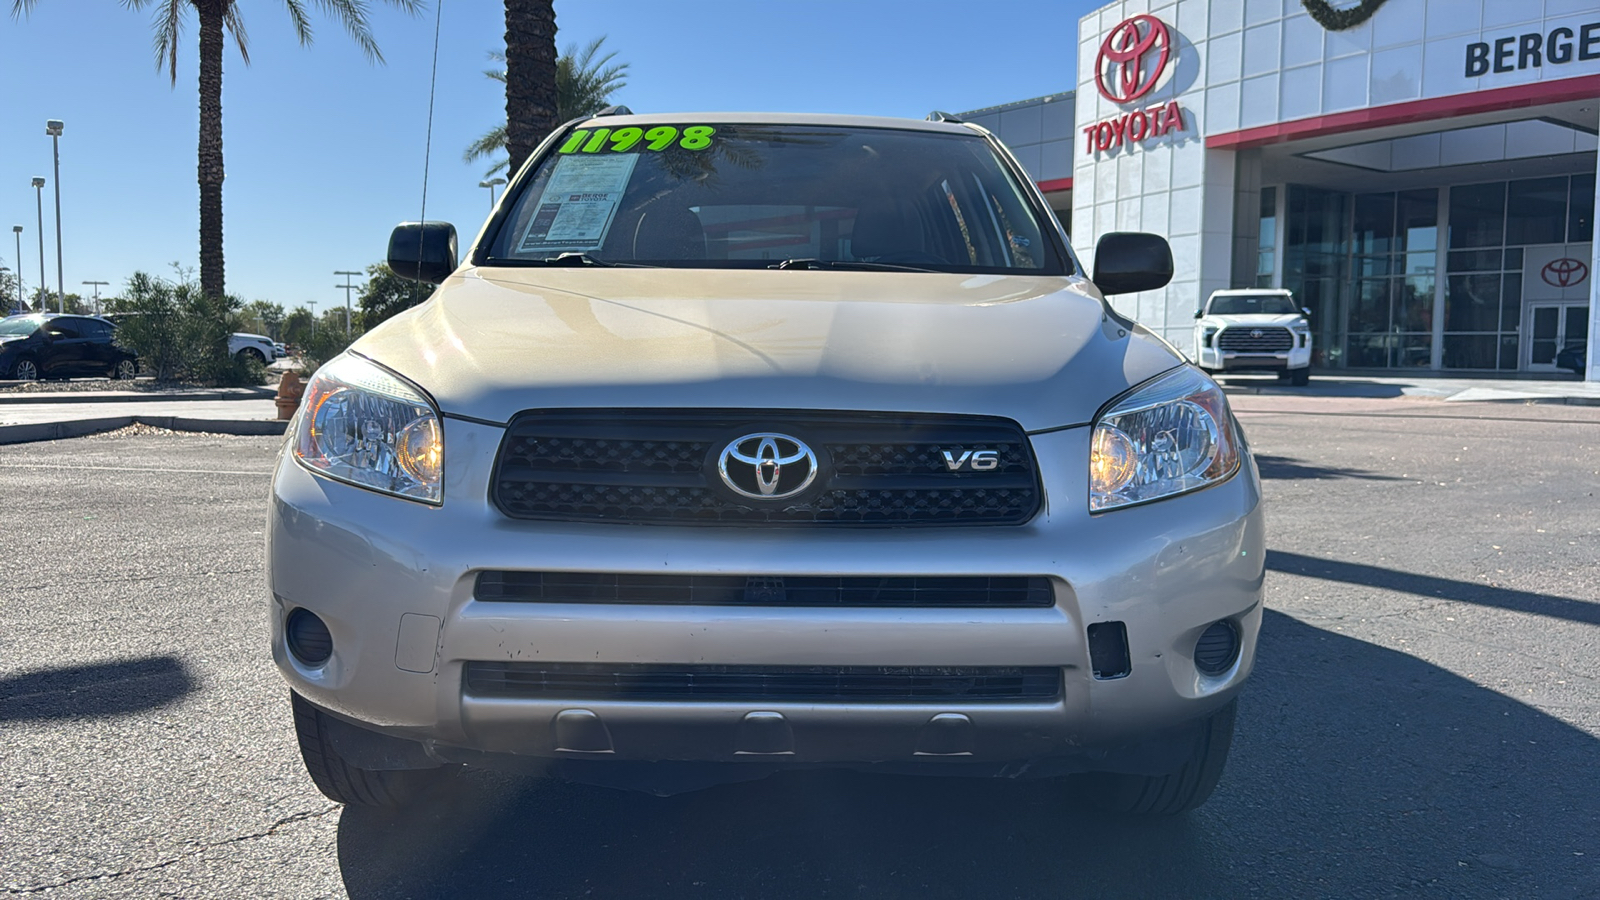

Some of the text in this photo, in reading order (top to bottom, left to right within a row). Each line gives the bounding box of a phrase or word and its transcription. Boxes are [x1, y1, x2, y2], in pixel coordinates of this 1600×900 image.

[1464, 22, 1600, 78] BERGE
[558, 125, 716, 154] 11998
[1083, 100, 1184, 155] TOYOTA
[942, 450, 998, 470] V6
